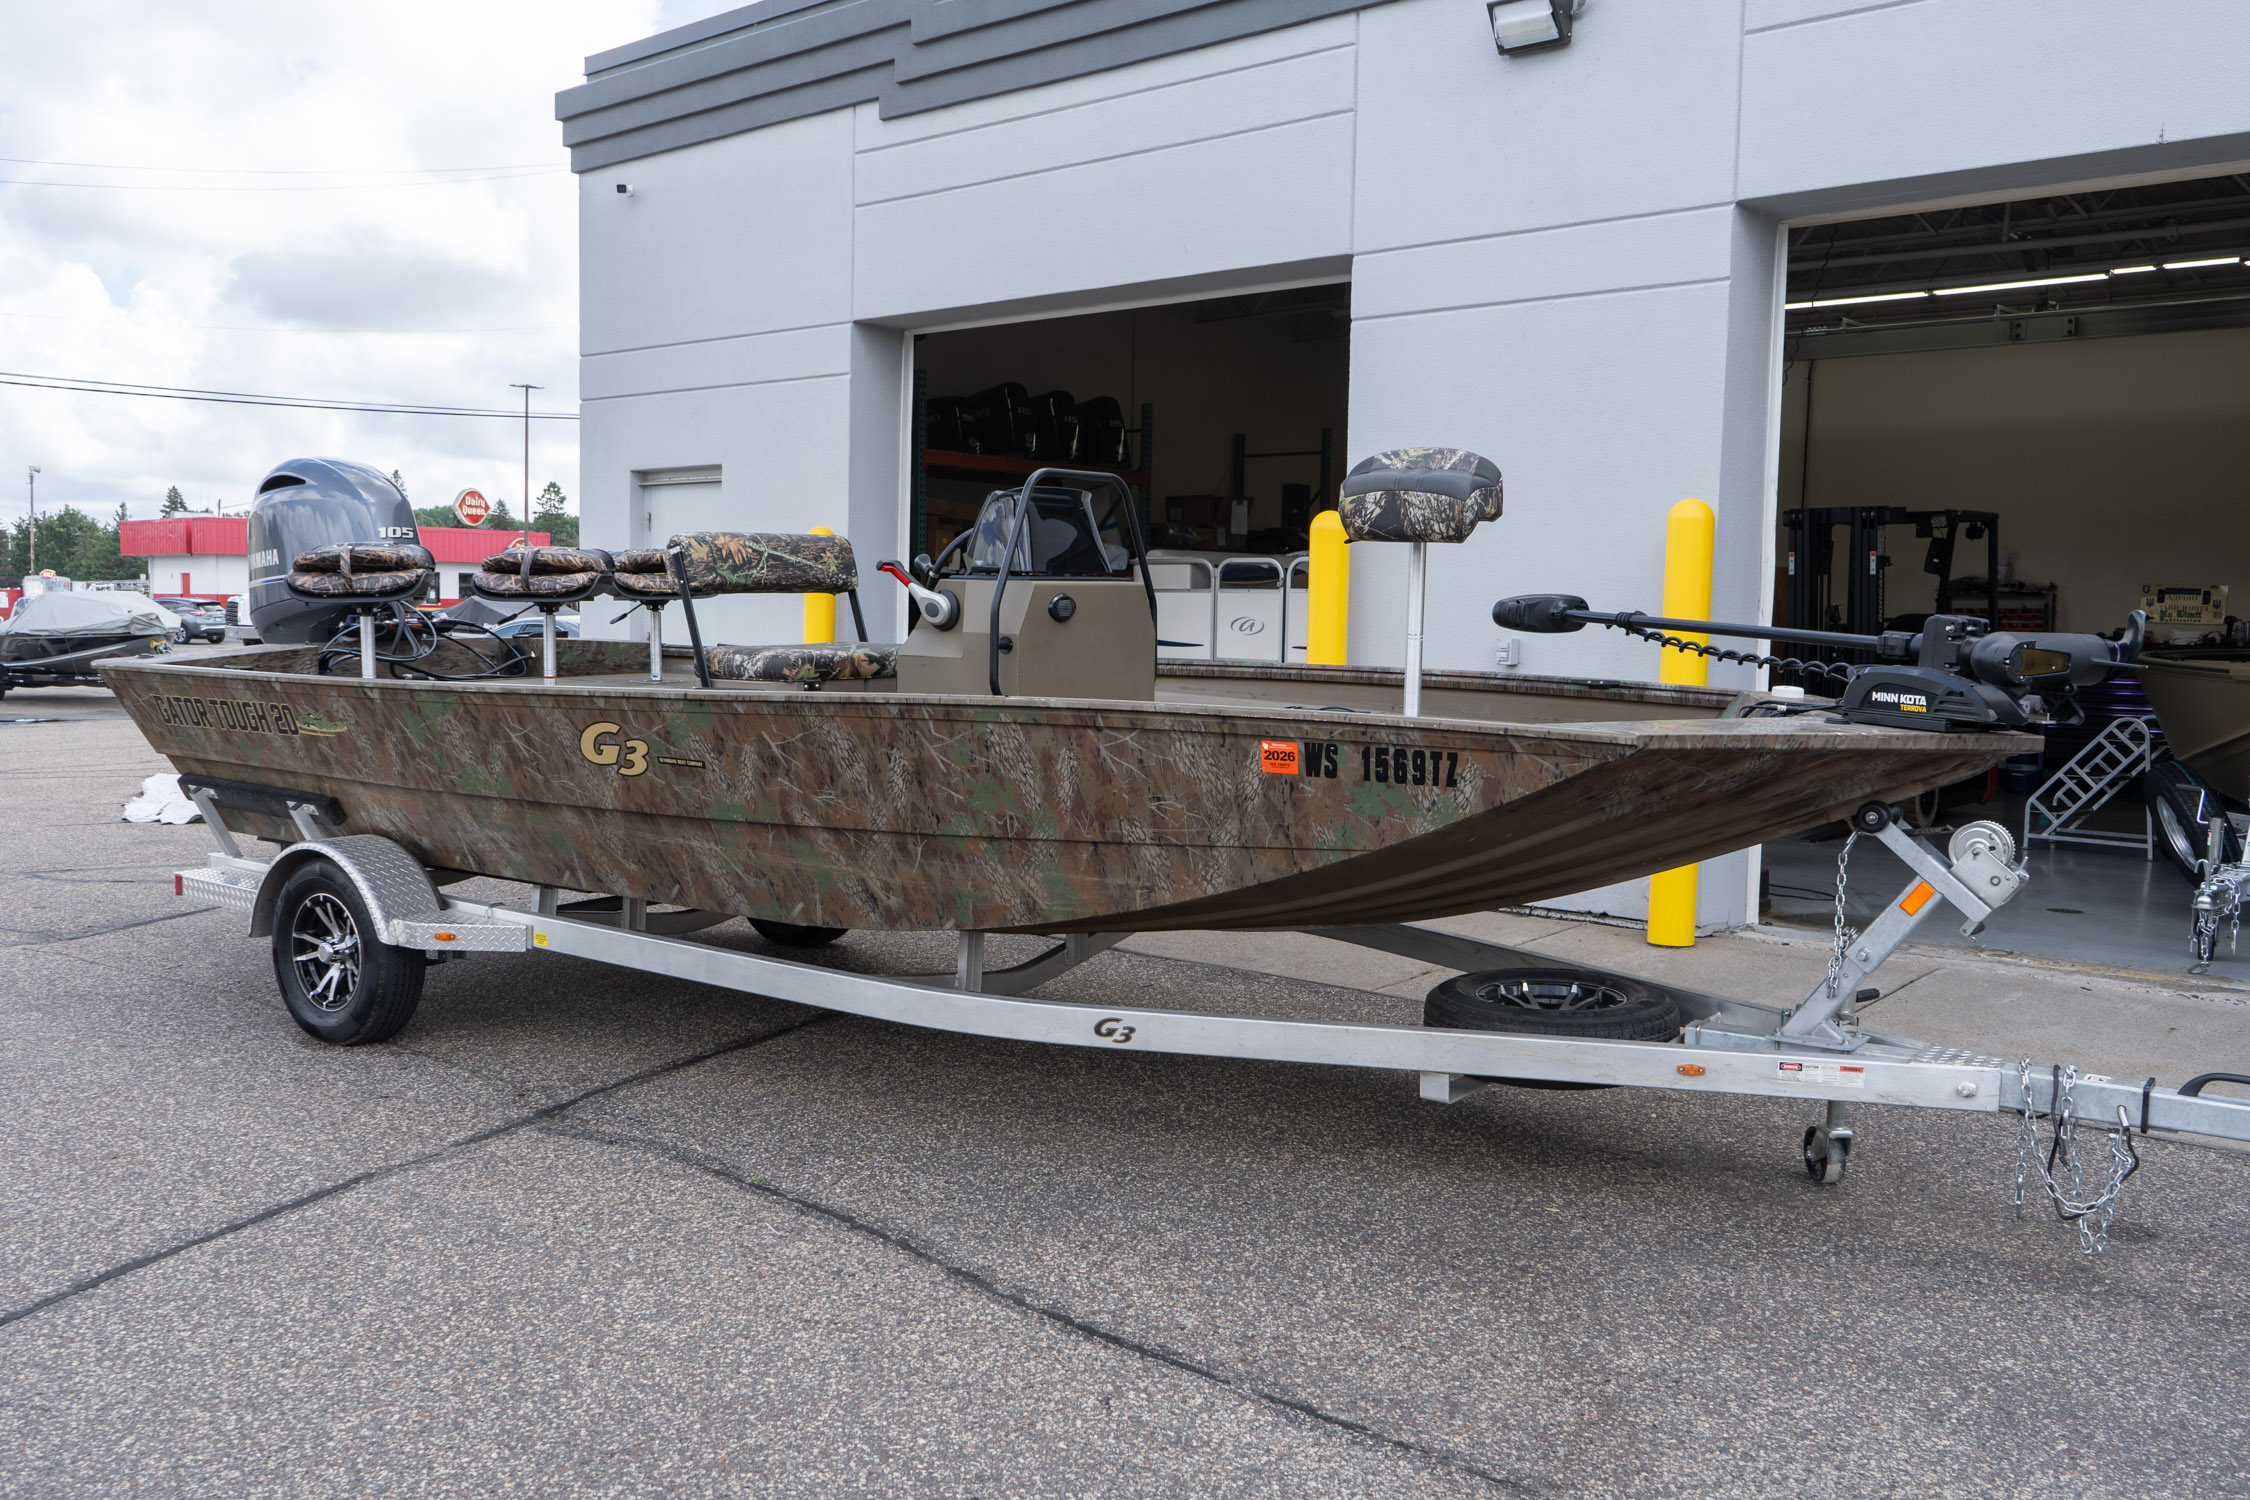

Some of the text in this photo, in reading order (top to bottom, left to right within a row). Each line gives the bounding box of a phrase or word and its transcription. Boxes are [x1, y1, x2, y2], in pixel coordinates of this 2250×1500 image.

[465, 496, 486, 508] Dairy
[462, 506, 486, 516] Queen
[378, 527, 414, 539] 105
[1872, 691, 1927, 706] MINN KOTA
[1900, 703, 1927, 713] TERROVA
[150, 694, 301, 736] GATOR TOUGH 20
[580, 721, 649, 777] G3
[1264, 750, 1296, 762] 2026
[1304, 742, 1459, 788] WS 1569TZ
[1093, 1016, 1137, 1044] G3
